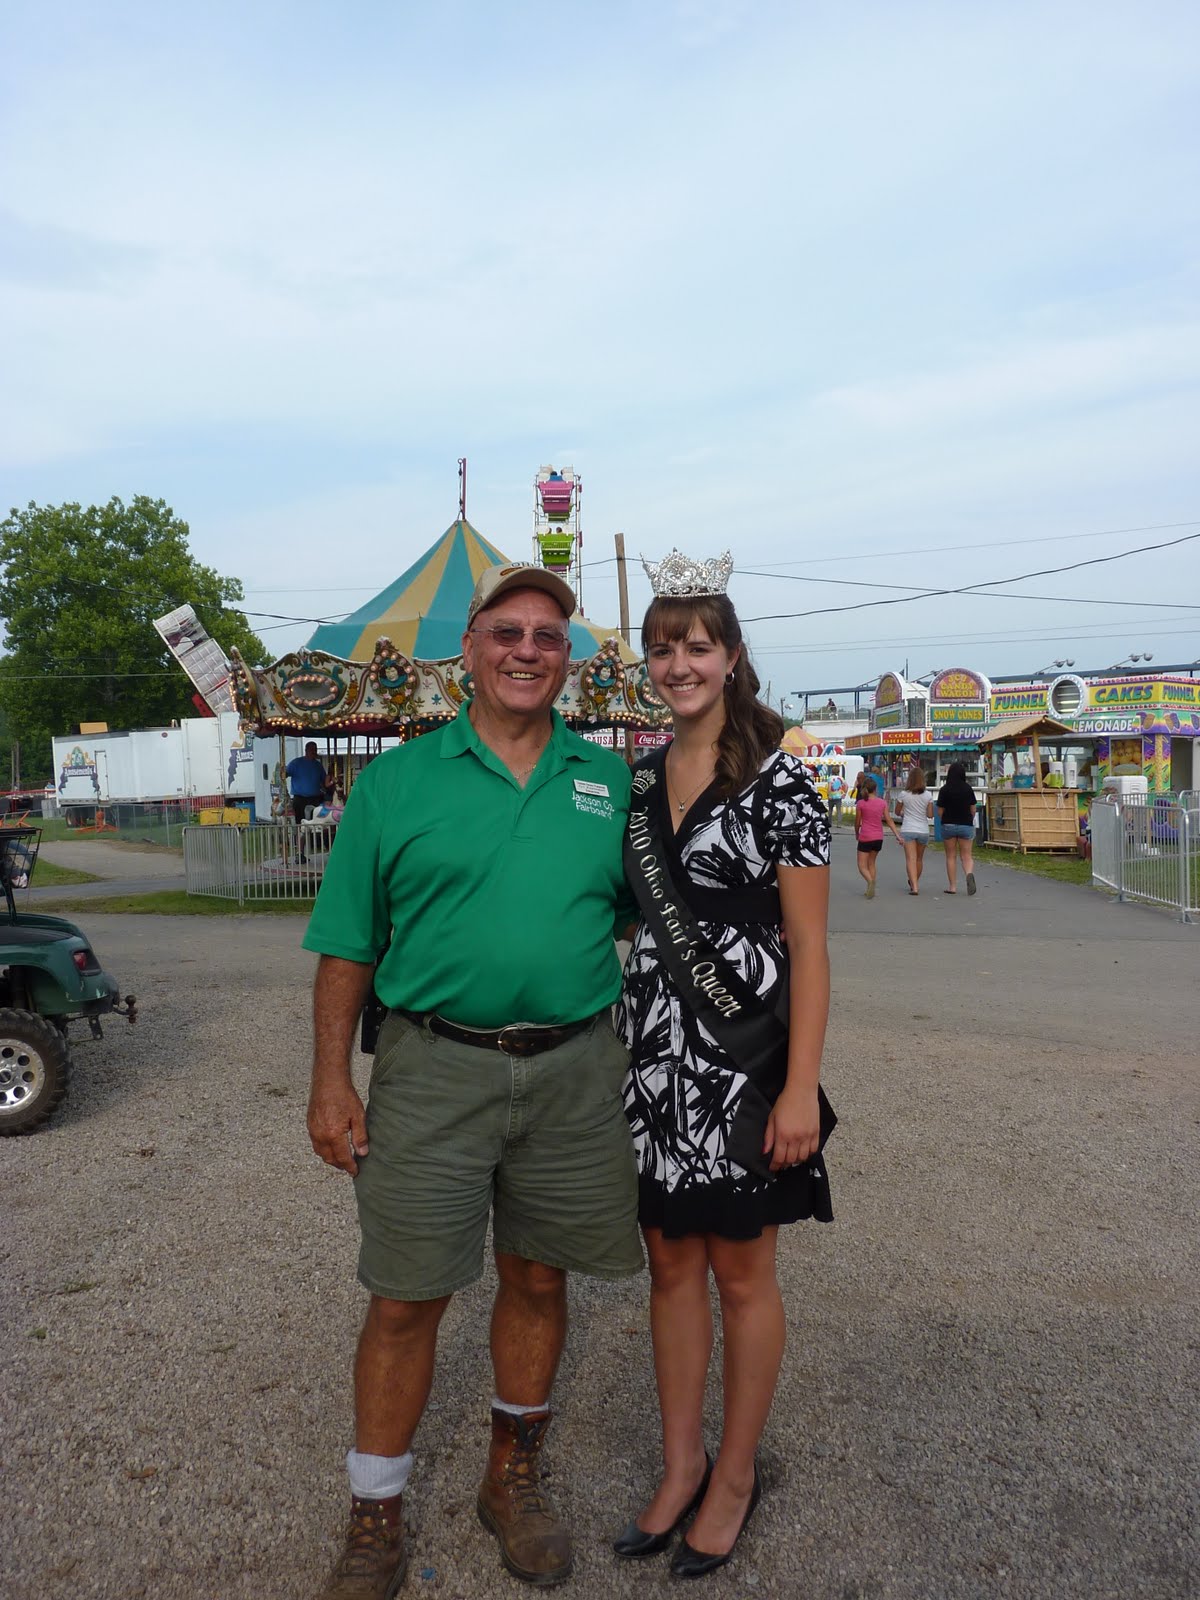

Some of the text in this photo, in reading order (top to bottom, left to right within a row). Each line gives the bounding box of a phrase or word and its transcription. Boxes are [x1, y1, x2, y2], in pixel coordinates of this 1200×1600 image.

[940, 690, 976, 698] WAGON
[994, 685, 1153, 710] FUNNEL CAKES
[1163, 685, 1195, 701] FUNNEL
[934, 710, 983, 720] SNOW CONES
[958, 727, 995, 739] FUNN
[1072, 720, 1133, 733] LEMONADE
[586, 736, 625, 745] SAUSAE
[571, 790, 602, 808] Jackson
[576, 801, 612, 820] Fairboard
[628, 805, 742, 1018] 2010 Ohio Fair's Queen
